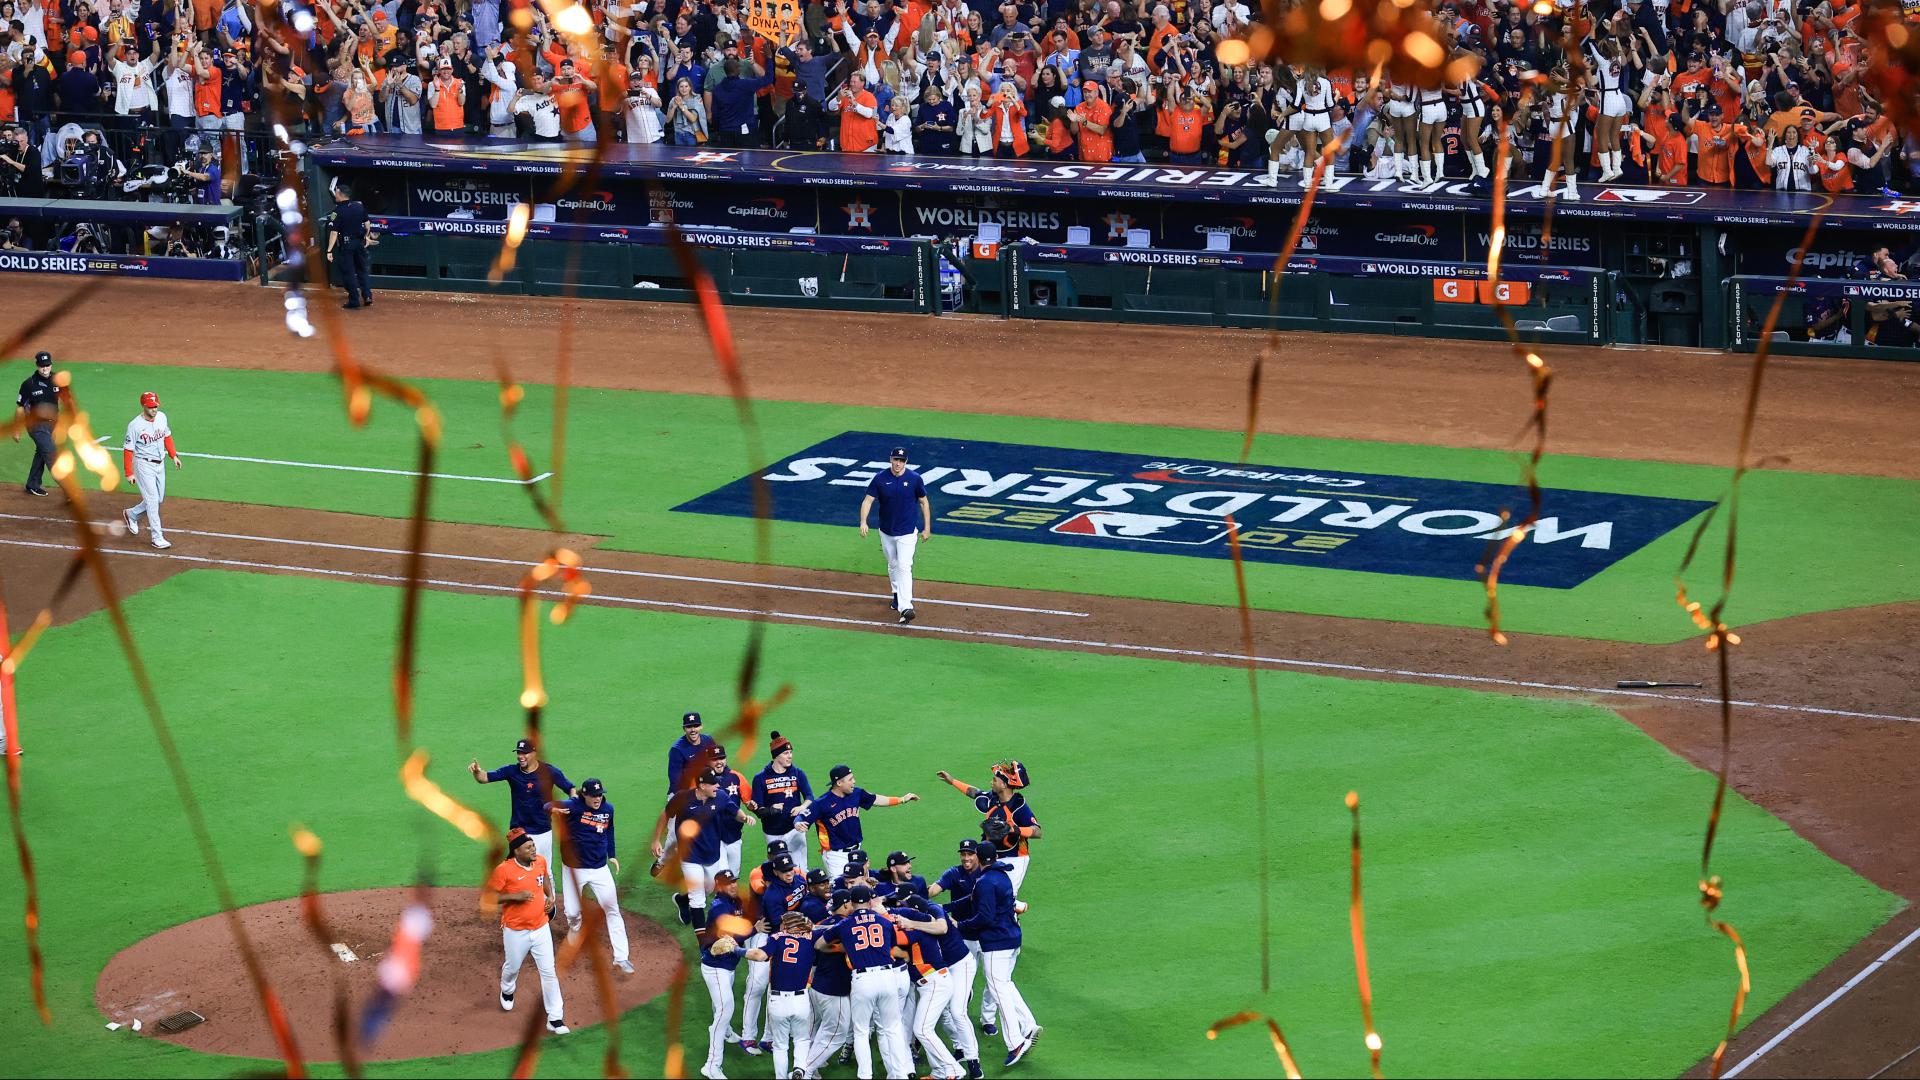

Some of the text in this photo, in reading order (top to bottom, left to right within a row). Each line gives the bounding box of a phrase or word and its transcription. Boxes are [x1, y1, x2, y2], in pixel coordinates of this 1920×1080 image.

[752, 16, 796, 31] DYNATY
[535, 93, 557, 111] Astro
[1446, 137, 1458, 155] 2
[380, 159, 403, 167] WORLD
[544, 166, 563, 174] SERIES
[665, 171, 688, 179] WORLD
[688, 172, 707, 180] SERIES
[811, 177, 834, 185] WORLD
[834, 178, 853, 186] SERIES
[649, 190, 676, 200] enjoy
[981, 185, 1000, 193] SERIES
[417, 188, 520, 205] WORLD SERIES
[1257, 196, 1301, 205] WORLD SERIES
[649, 198, 694, 208] the show.
[1410, 202, 1434, 210] WORLD
[916, 206, 1060, 230] WORLD SERIES
[1590, 210, 1611, 218] SERIES
[1723, 215, 1769, 224] WORLD SERIES
[434, 222, 507, 234] WORLD SERIES
[1310, 226, 1339, 235] show.
[1882, 222, 1907, 230] WORLD
[695, 233, 736, 245] WORLD
[737, 235, 771, 247] SERIES
[1478, 232, 1590, 251] WRLD SERIES
[41, 256, 87, 271] SERIES
[1119, 252, 1161, 263] WORLD
[1162, 254, 1197, 265] SERIES
[1377, 263, 1420, 274] WORLD
[1421, 266, 1457, 276] SERIES
[1442, 281, 1458, 298] G
[1494, 283, 1510, 300] G
[1860, 286, 1904, 298] WORLD
[1165, 490, 1613, 550] WORLD
[854, 913, 876, 924] LEE
[851, 923, 885, 951] 38
[782, 937, 800, 964] 2
